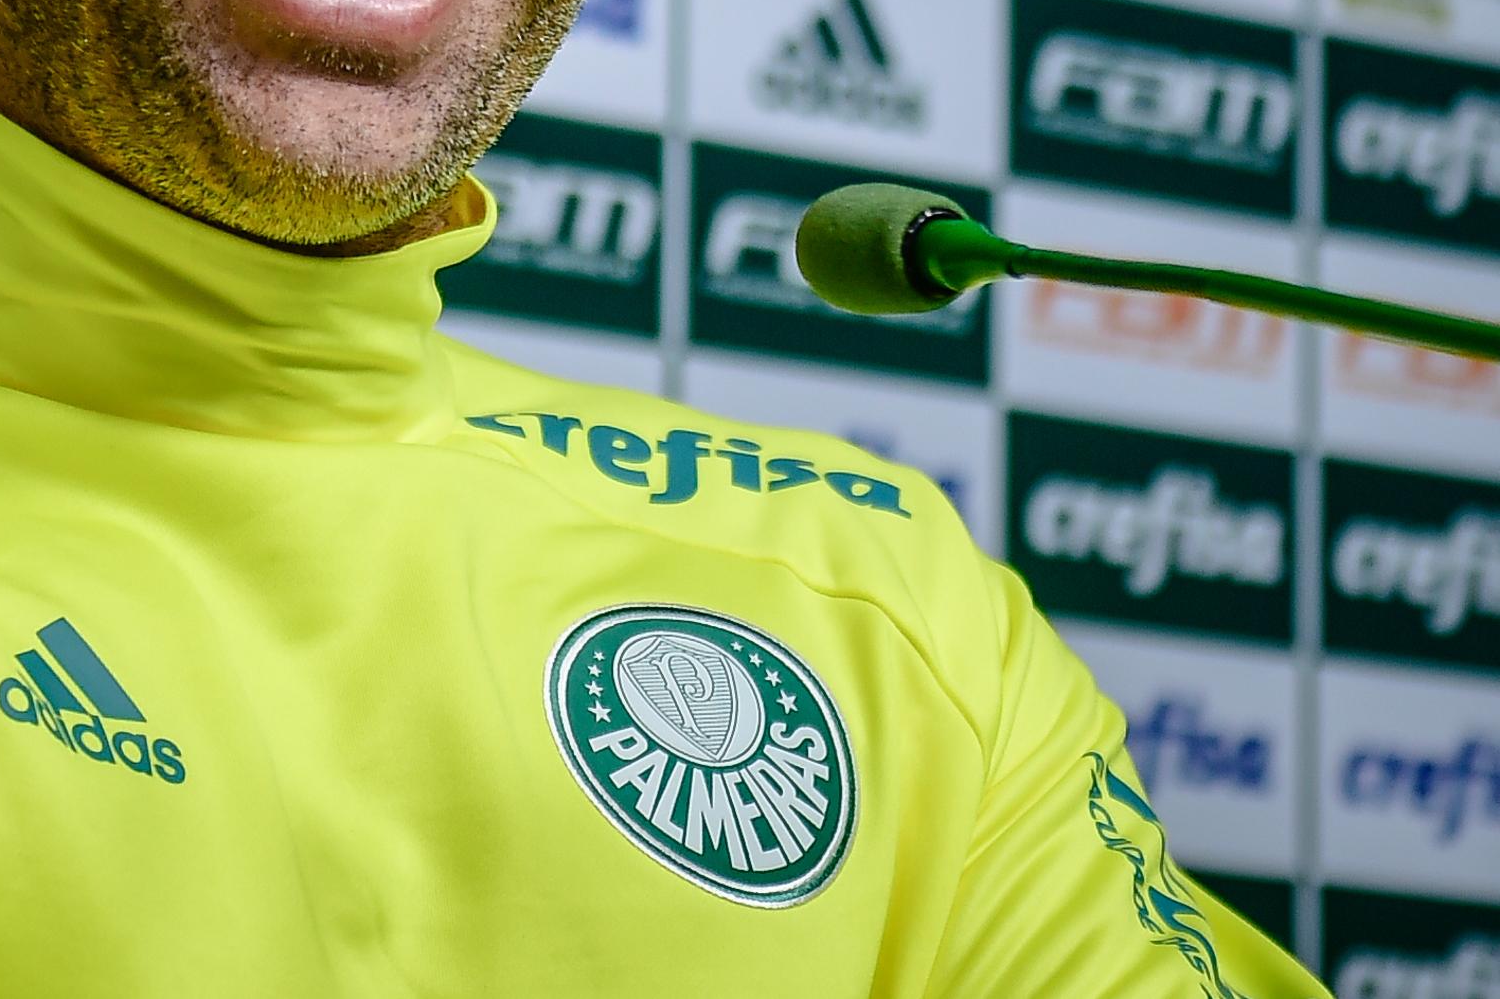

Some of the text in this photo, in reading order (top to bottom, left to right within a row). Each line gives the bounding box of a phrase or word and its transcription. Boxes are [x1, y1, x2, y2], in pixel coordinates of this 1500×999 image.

[1031, 33, 1293, 153] Fam
[464, 412, 912, 519] crefisa
[1026, 465, 1283, 596] crefisa
[588, 721, 831, 873] PALMEIRAS
